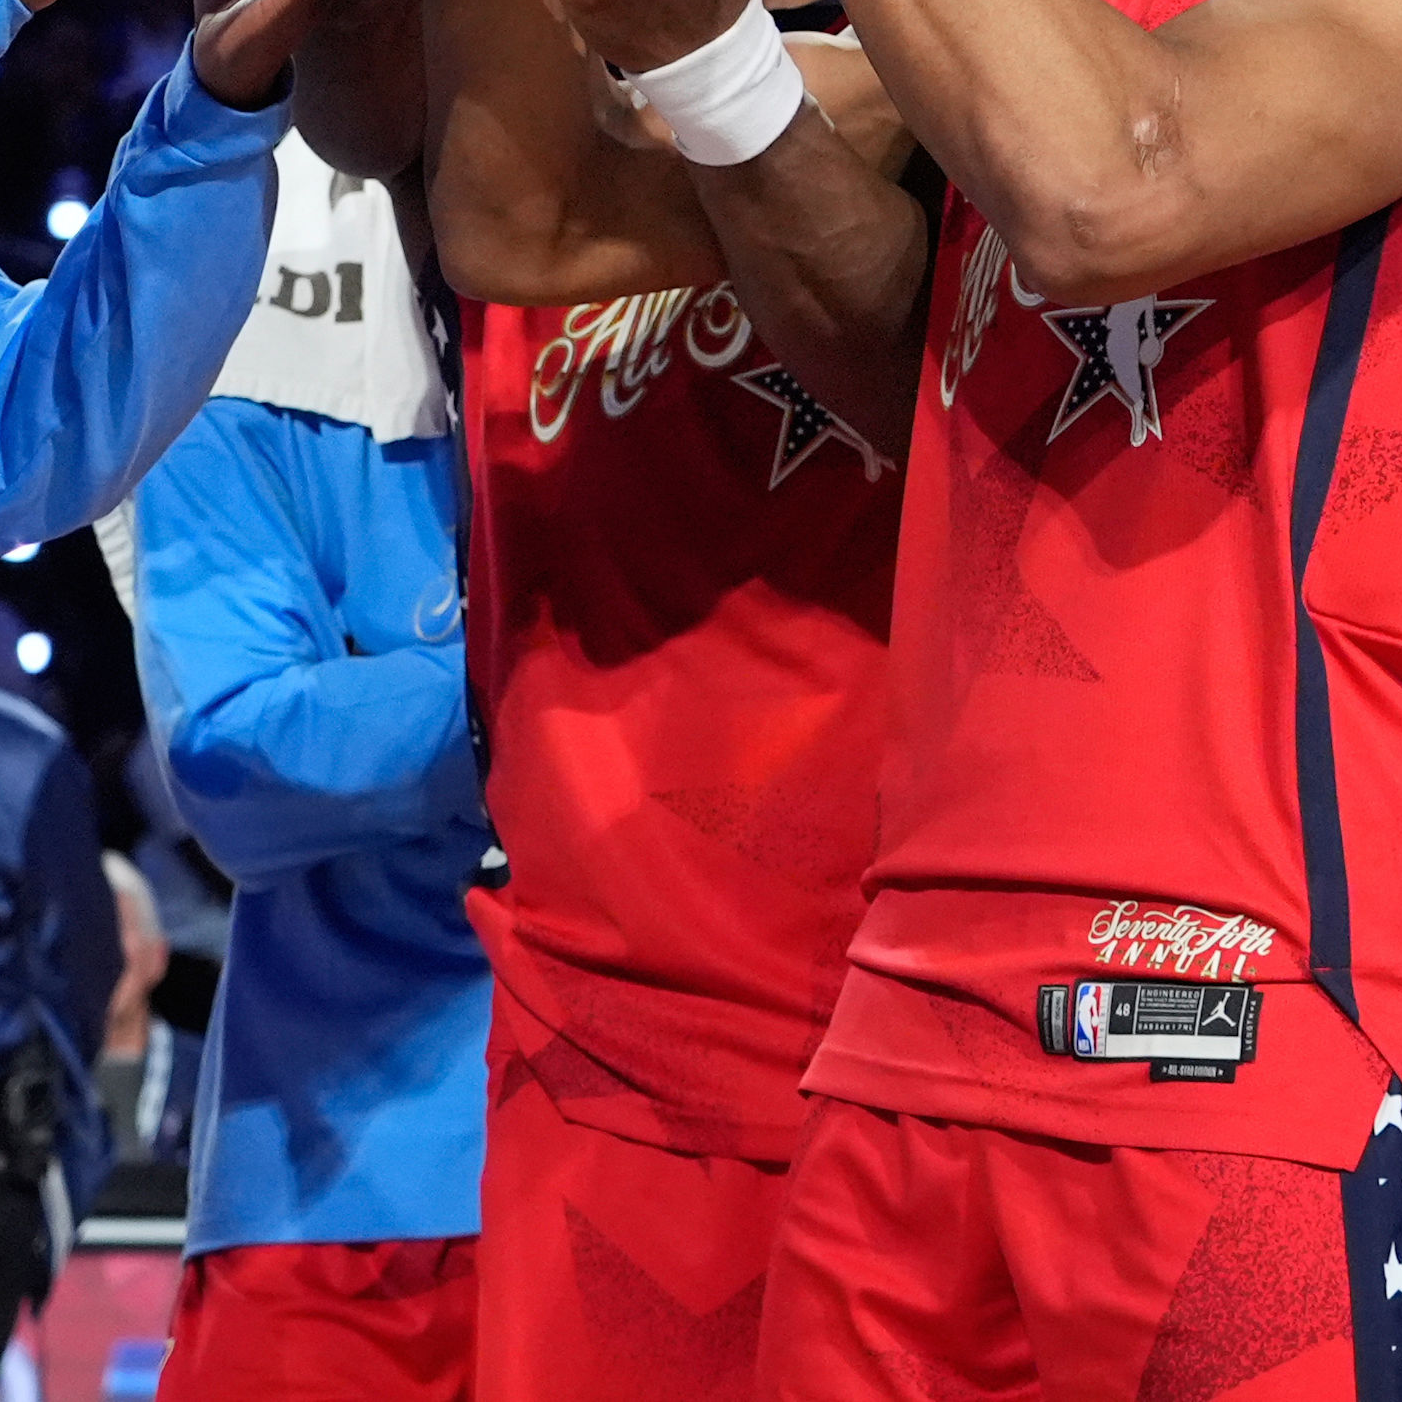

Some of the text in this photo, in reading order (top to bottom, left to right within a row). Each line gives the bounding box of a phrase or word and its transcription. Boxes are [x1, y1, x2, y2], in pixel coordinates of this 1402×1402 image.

[1088, 900, 1277, 956] Seventy Fifth
[1095, 938, 1248, 983] ANNUAL
[1115, 1002, 1130, 1017] 48
